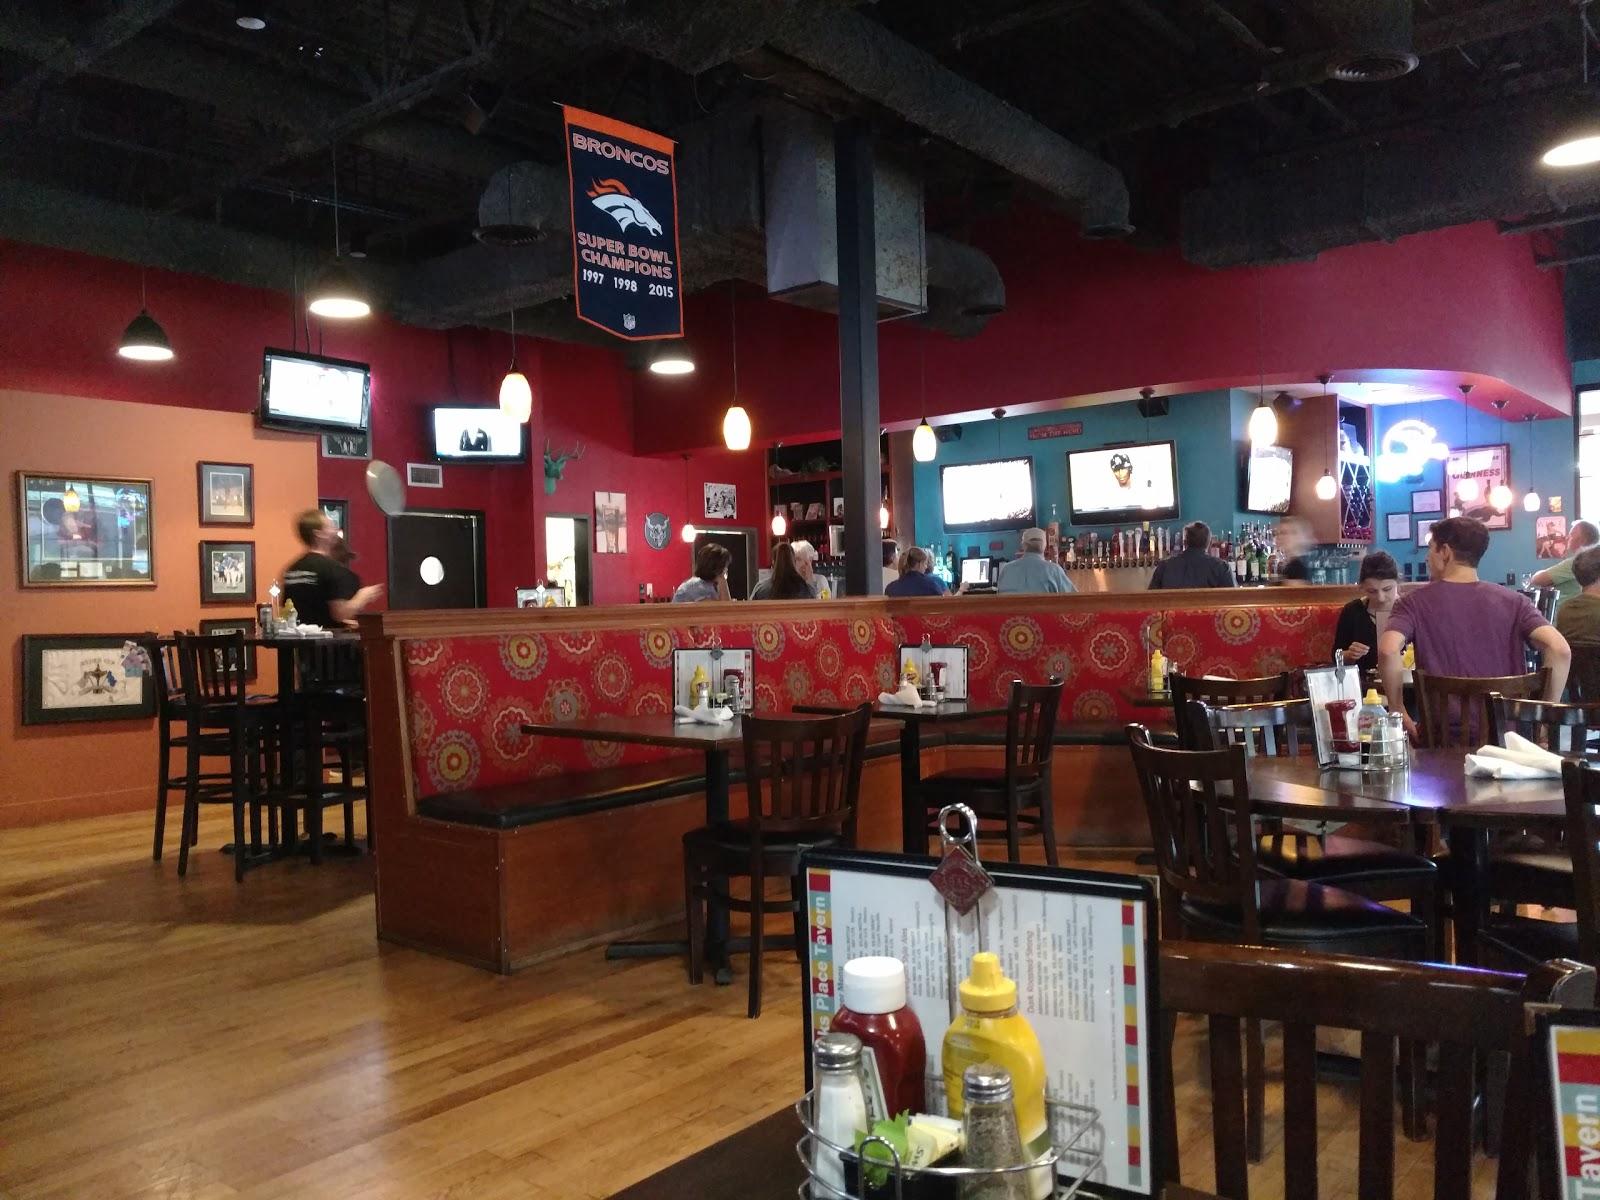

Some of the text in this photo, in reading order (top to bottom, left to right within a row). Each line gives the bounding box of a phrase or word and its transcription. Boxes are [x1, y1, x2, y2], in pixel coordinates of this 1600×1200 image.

[572, 132, 670, 175] BRONCOS
[578, 231, 674, 265] SUPER BOWL
[581, 248, 673, 280] CHAMPIONS
[582, 268, 674, 298] 1997 1998 2015
[814, 896, 828, 956] Tavern
[816, 960, 830, 1011] Place
[1574, 1094, 1600, 1200] Tavern
